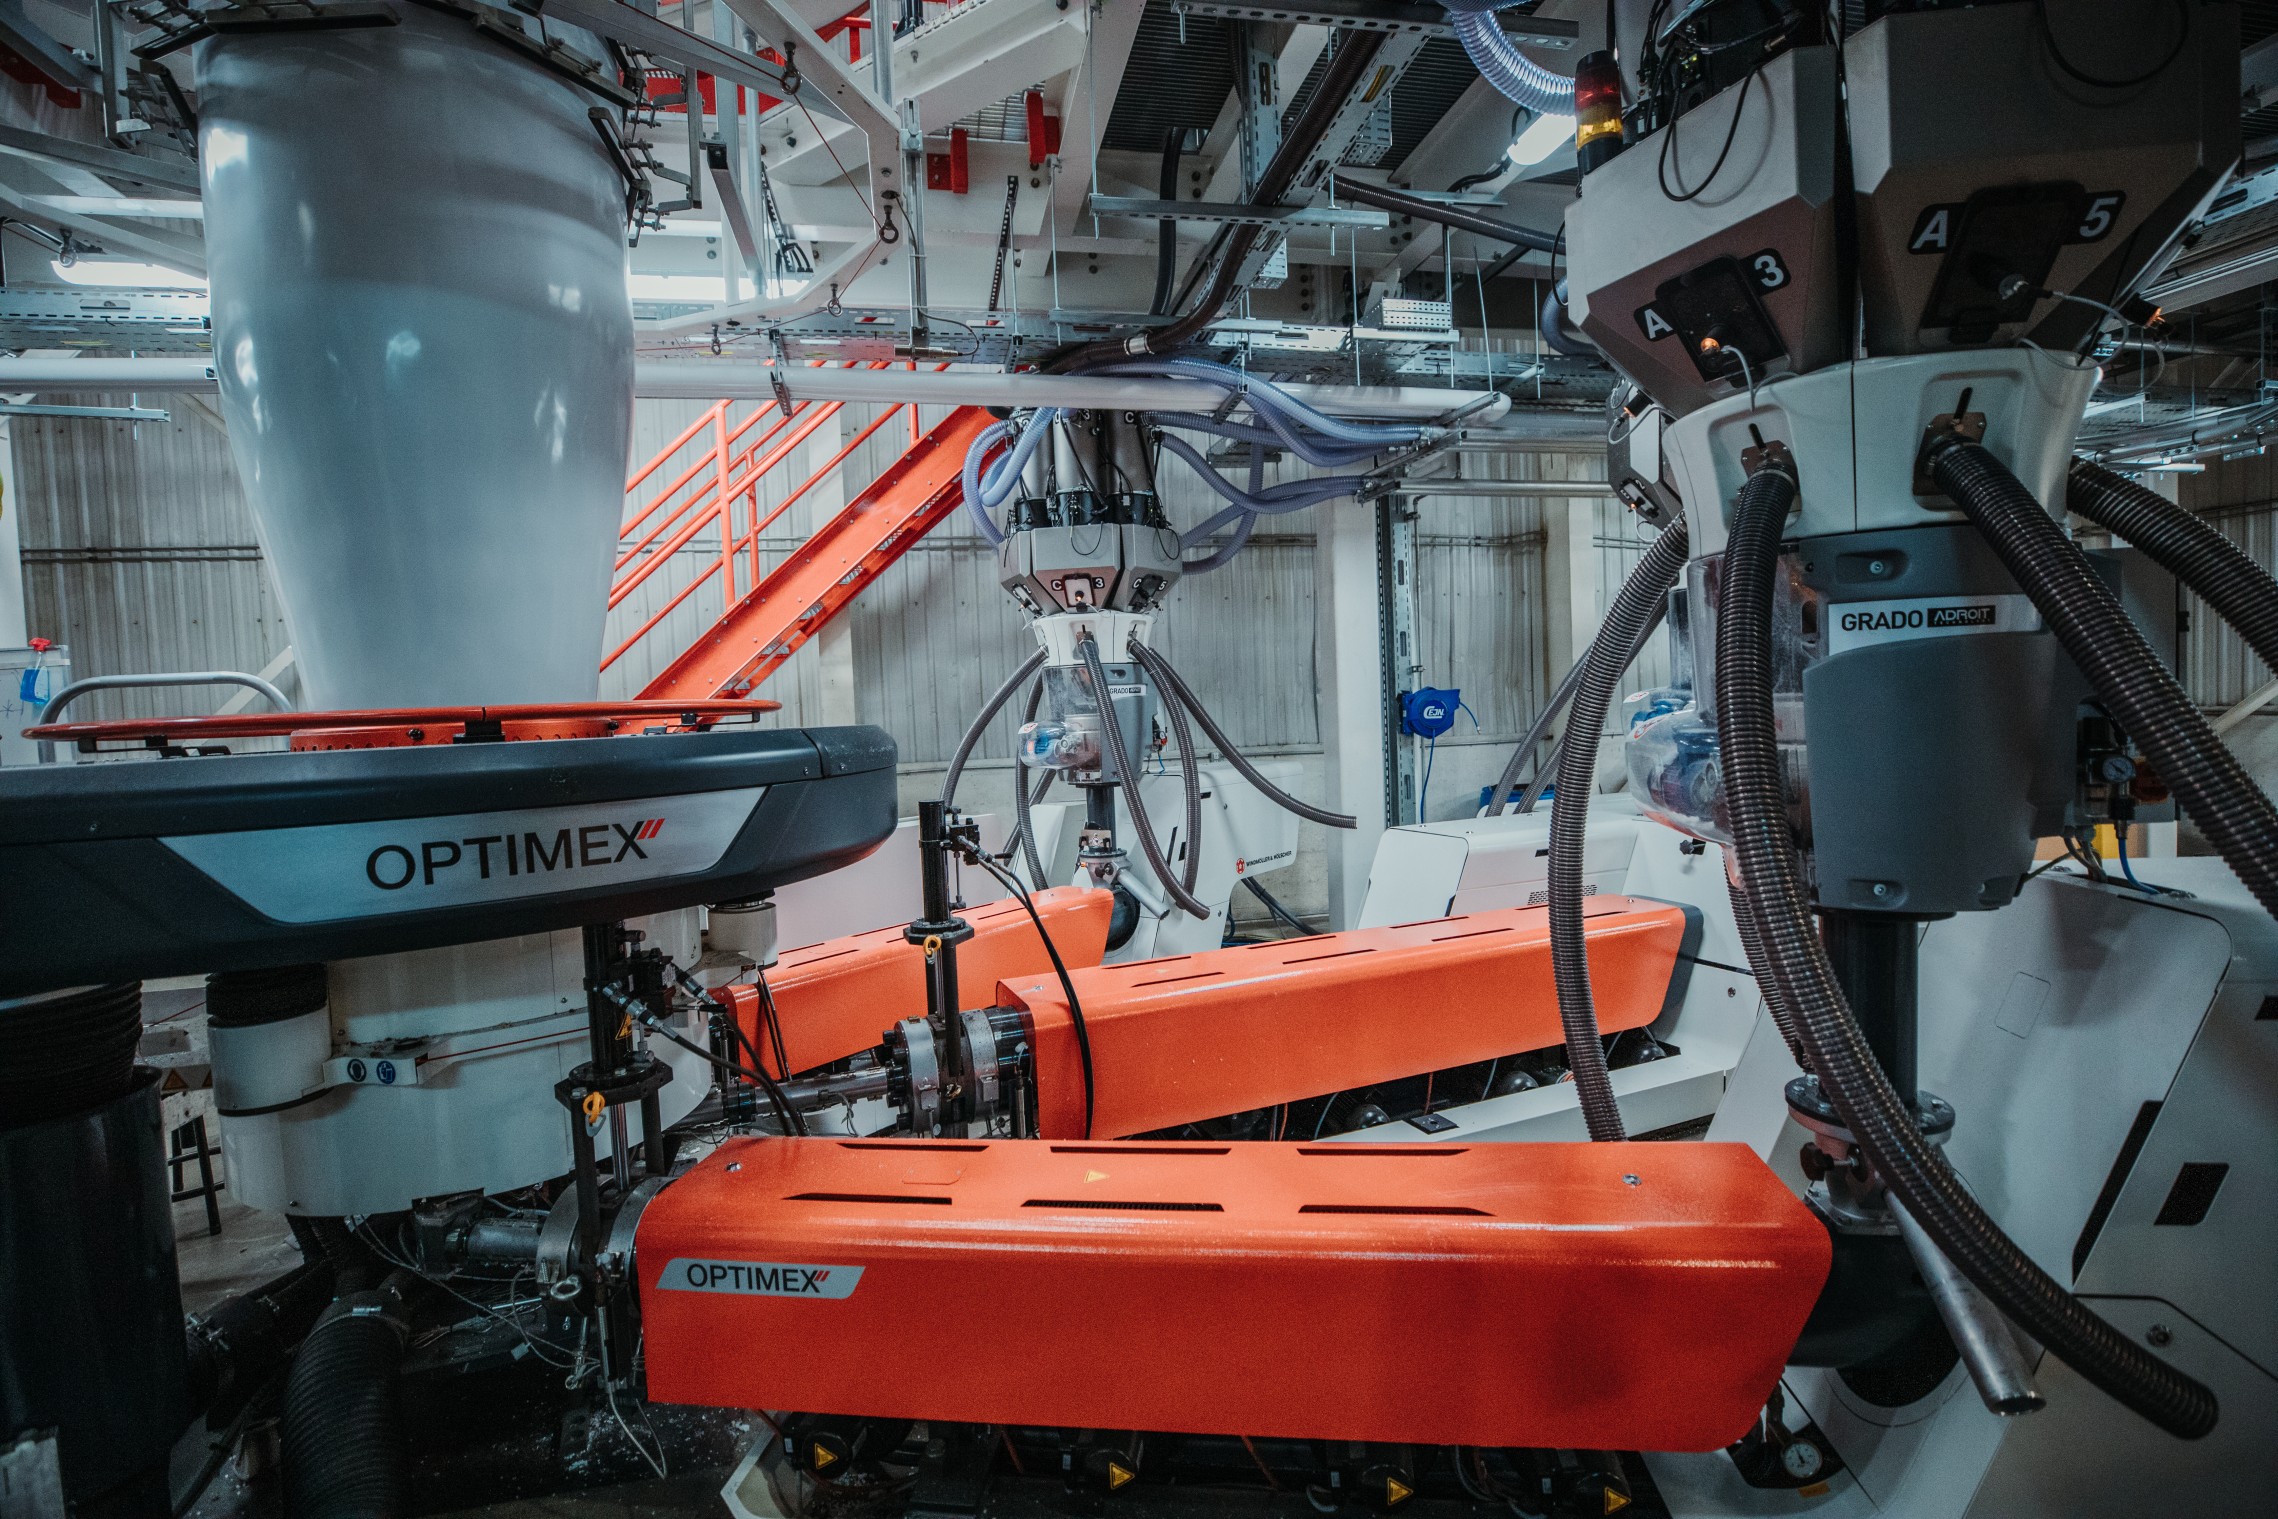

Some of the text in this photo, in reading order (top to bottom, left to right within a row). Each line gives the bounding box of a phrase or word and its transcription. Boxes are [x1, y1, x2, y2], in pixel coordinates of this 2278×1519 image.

[1912, 198, 2117, 249] A 5
[1643, 255, 1785, 340] A 3
[1125, 412, 1135, 423] C
[1052, 578, 1104, 590] C 3
[1133, 578, 1166, 590] C 5
[1841, 608, 1991, 632] GRADO ADROIT
[1423, 706, 1444, 719] CEJN
[365, 820, 648, 890] OPTIMEX
[686, 1263, 820, 1294] OPTIMEX
